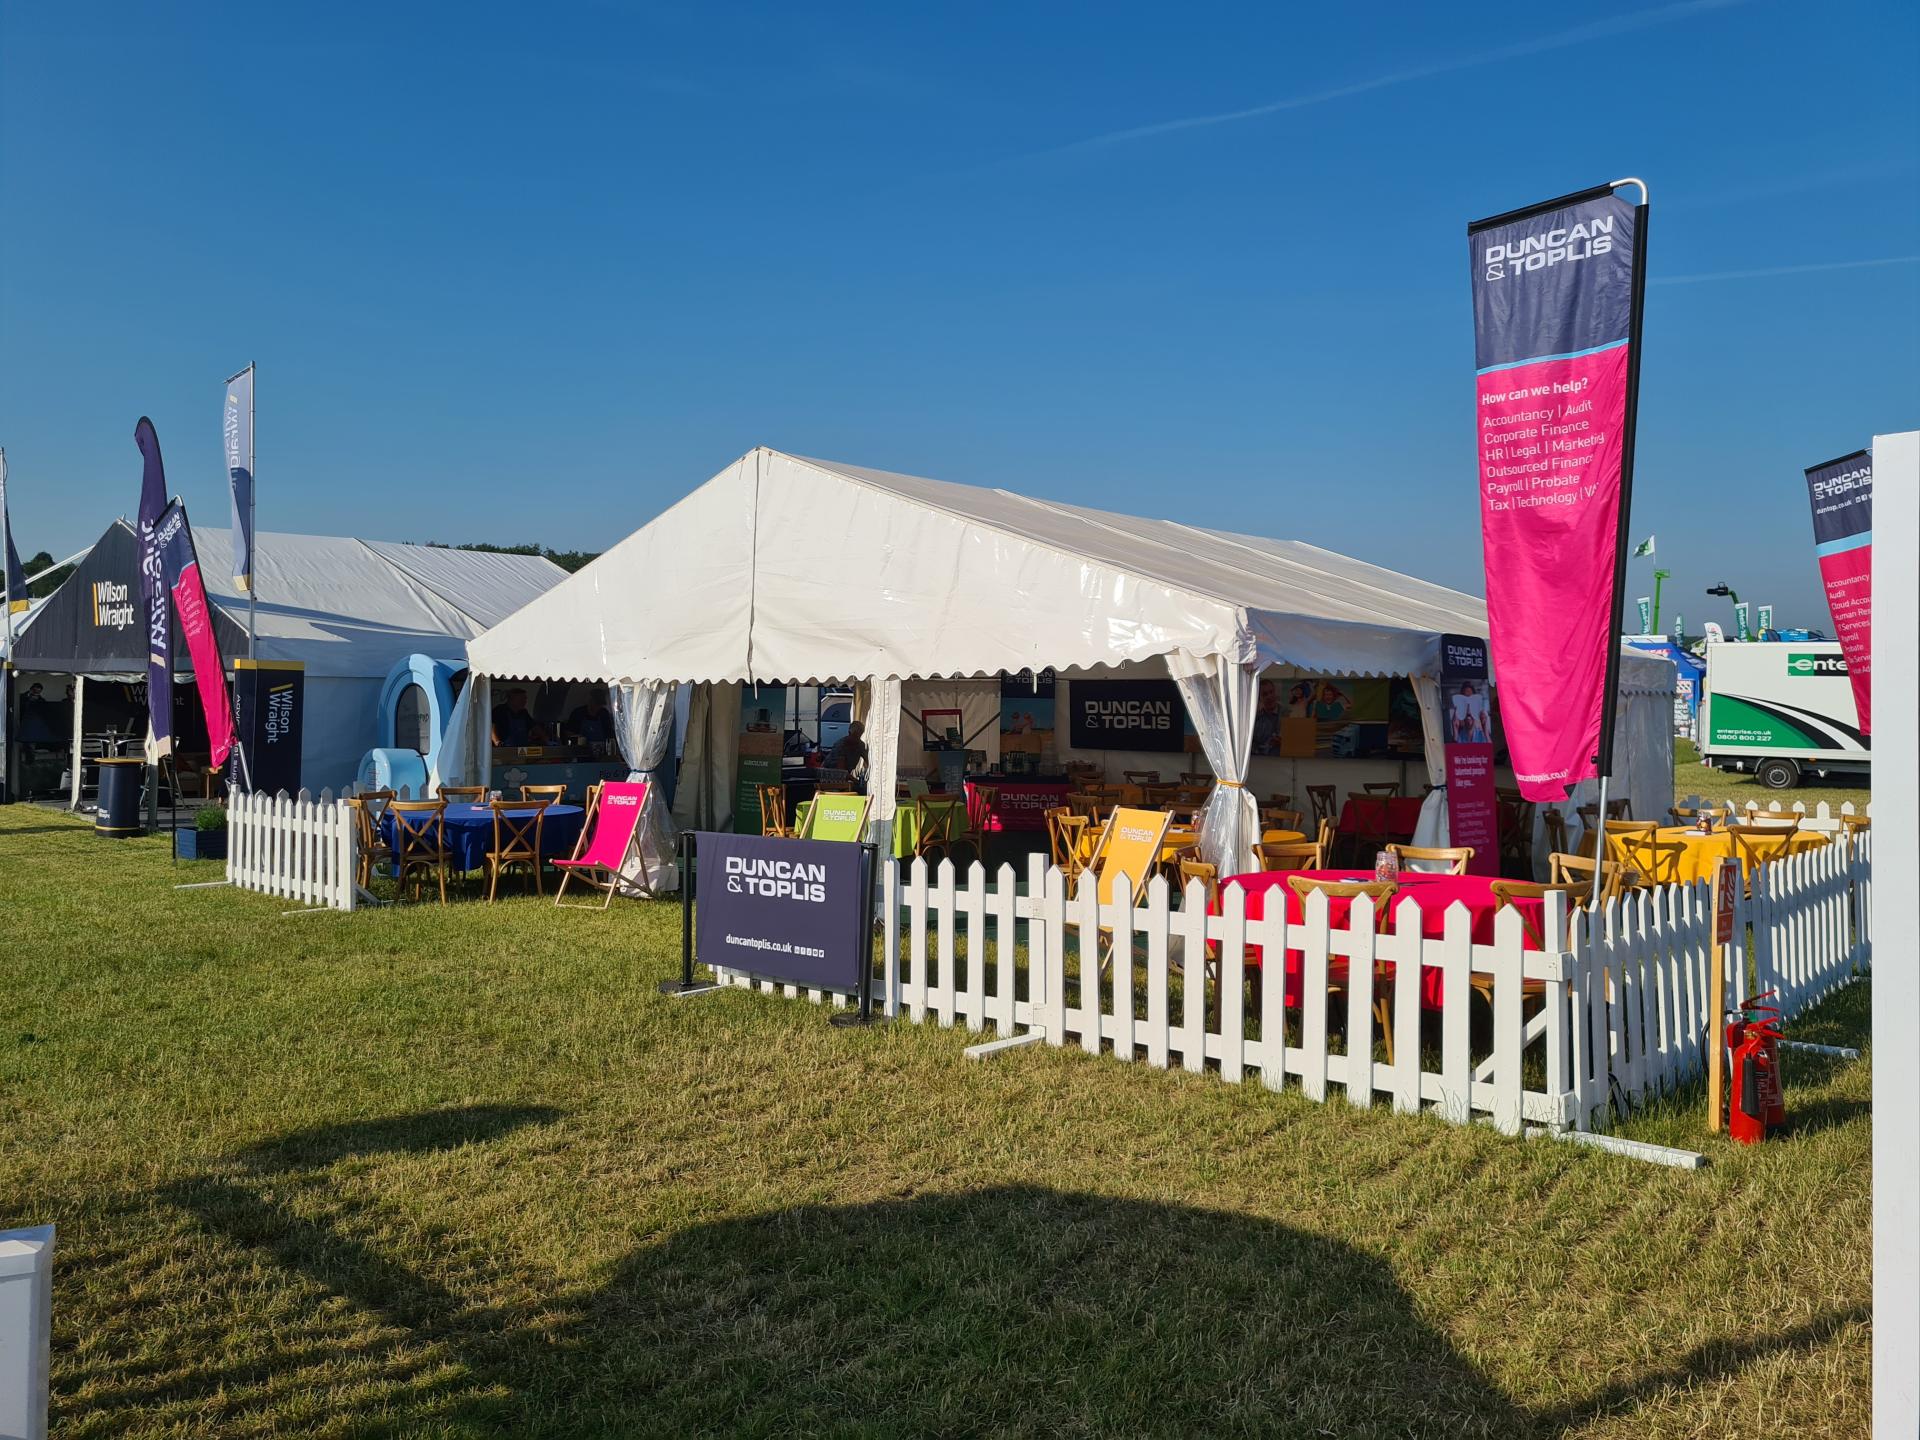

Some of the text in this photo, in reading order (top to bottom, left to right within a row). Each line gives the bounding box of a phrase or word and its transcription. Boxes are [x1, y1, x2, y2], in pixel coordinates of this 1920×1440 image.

[1485, 215, 1613, 265] DUNCAN
[1486, 235, 1613, 282] & TOPLIS
[1482, 377, 1589, 406] How can we help?
[1482, 408, 1555, 429] Accountancy
[1564, 399, 1593, 417] Audit
[1484, 419, 1590, 446] Corporate Finance
[1485, 448, 1504, 462] HR
[1510, 443, 1542, 459] Legal
[1486, 453, 1594, 478] Outsourced Financ
[1487, 479, 1524, 496] Payroll
[1531, 473, 1580, 489] Probate
[1813, 466, 1872, 492] DUNCAN
[1825, 475, 1872, 497] TOPLIS
[1488, 498, 1509, 511] Tax
[1517, 490, 1578, 508] Technology
[1584, 481, 1600, 498] VA
[98, 580, 128, 603] Wilson
[1826, 573, 1870, 589] Accountancy
[1829, 589, 1846, 600] Audit
[98, 602, 135, 631] Wraight
[1447, 645, 1483, 657] DUNCAN
[1456, 656, 1483, 667] TOPLIS
[265, 693, 281, 744] Wraight
[281, 690, 293, 733] Wilson
[1085, 700, 1171, 715] DUNCAN
[1085, 715, 1171, 730] & TOPLIS
[1000, 793, 1059, 802] DUNCAN
[1121, 826, 1154, 836] DUNCAN
[725, 856, 826, 883] DUNCAN
[726, 875, 826, 903] & TOPLIS
[725, 933, 793, 954] duncantoplis.co.uk
